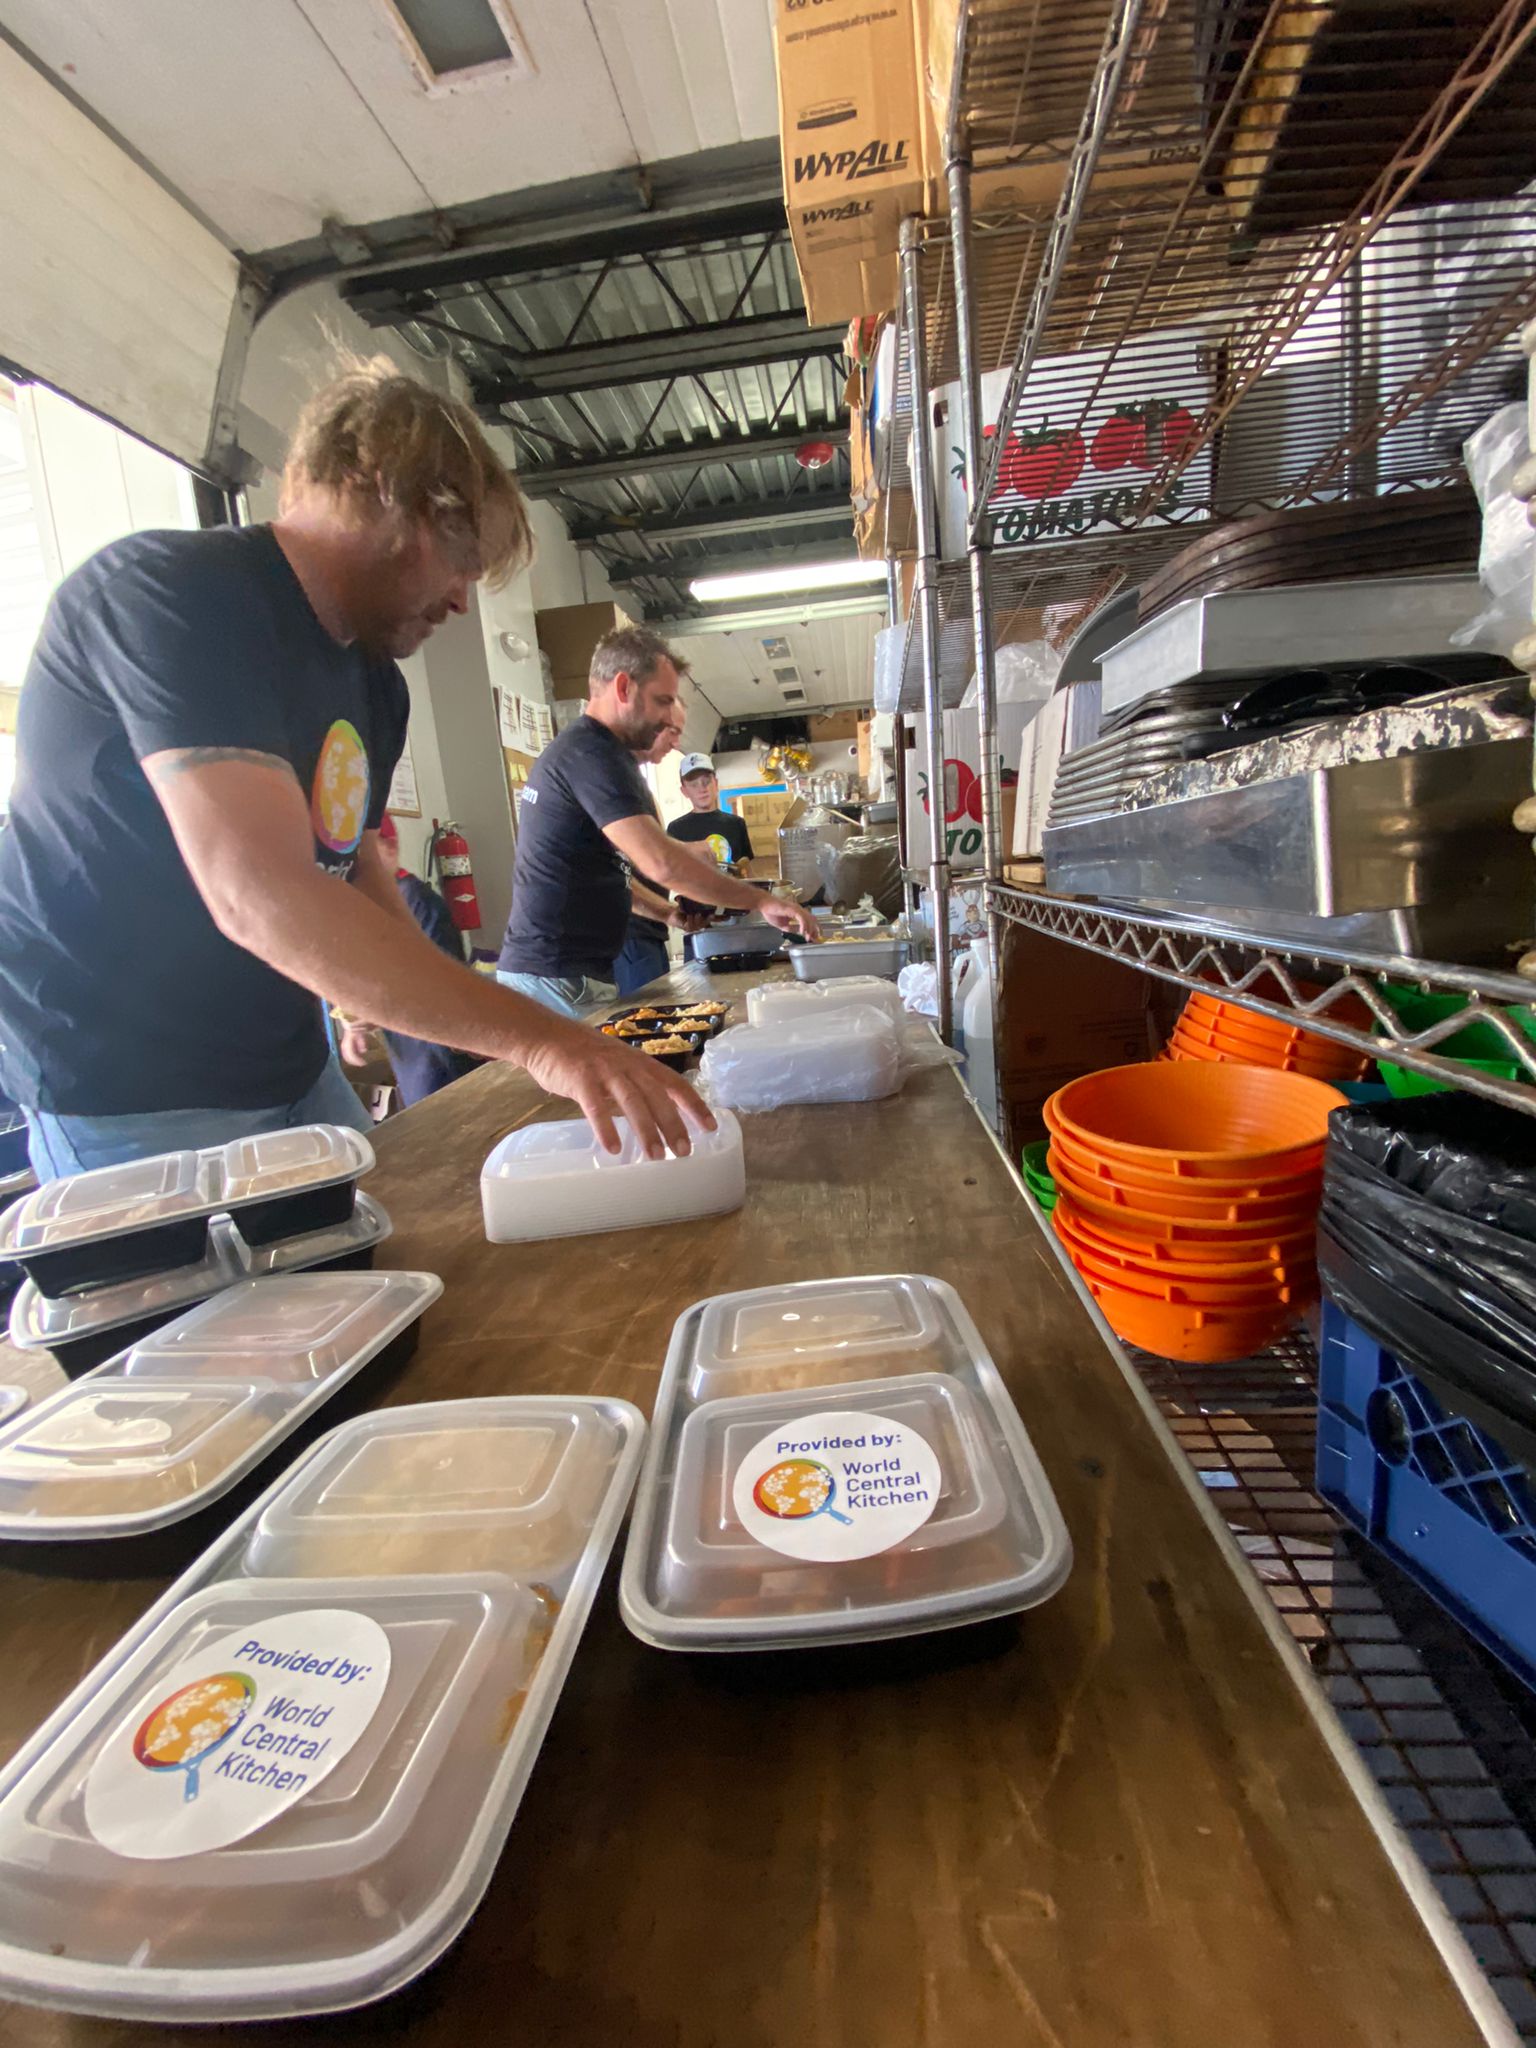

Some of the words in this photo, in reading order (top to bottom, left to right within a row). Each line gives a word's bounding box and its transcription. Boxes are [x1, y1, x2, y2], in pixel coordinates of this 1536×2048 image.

[776, 1436, 867, 1454] Provided
[871, 1433, 903, 1448] by:
[842, 1458, 900, 1476] World
[846, 1472, 921, 1493] Central
[847, 1490, 929, 1509] Kitchen
[233, 1640, 339, 1676] Provided
[332, 1657, 373, 1685] by:
[263, 1695, 335, 1728] World
[241, 1723, 332, 1761] Central
[214, 1751, 308, 1792] Kitchen
